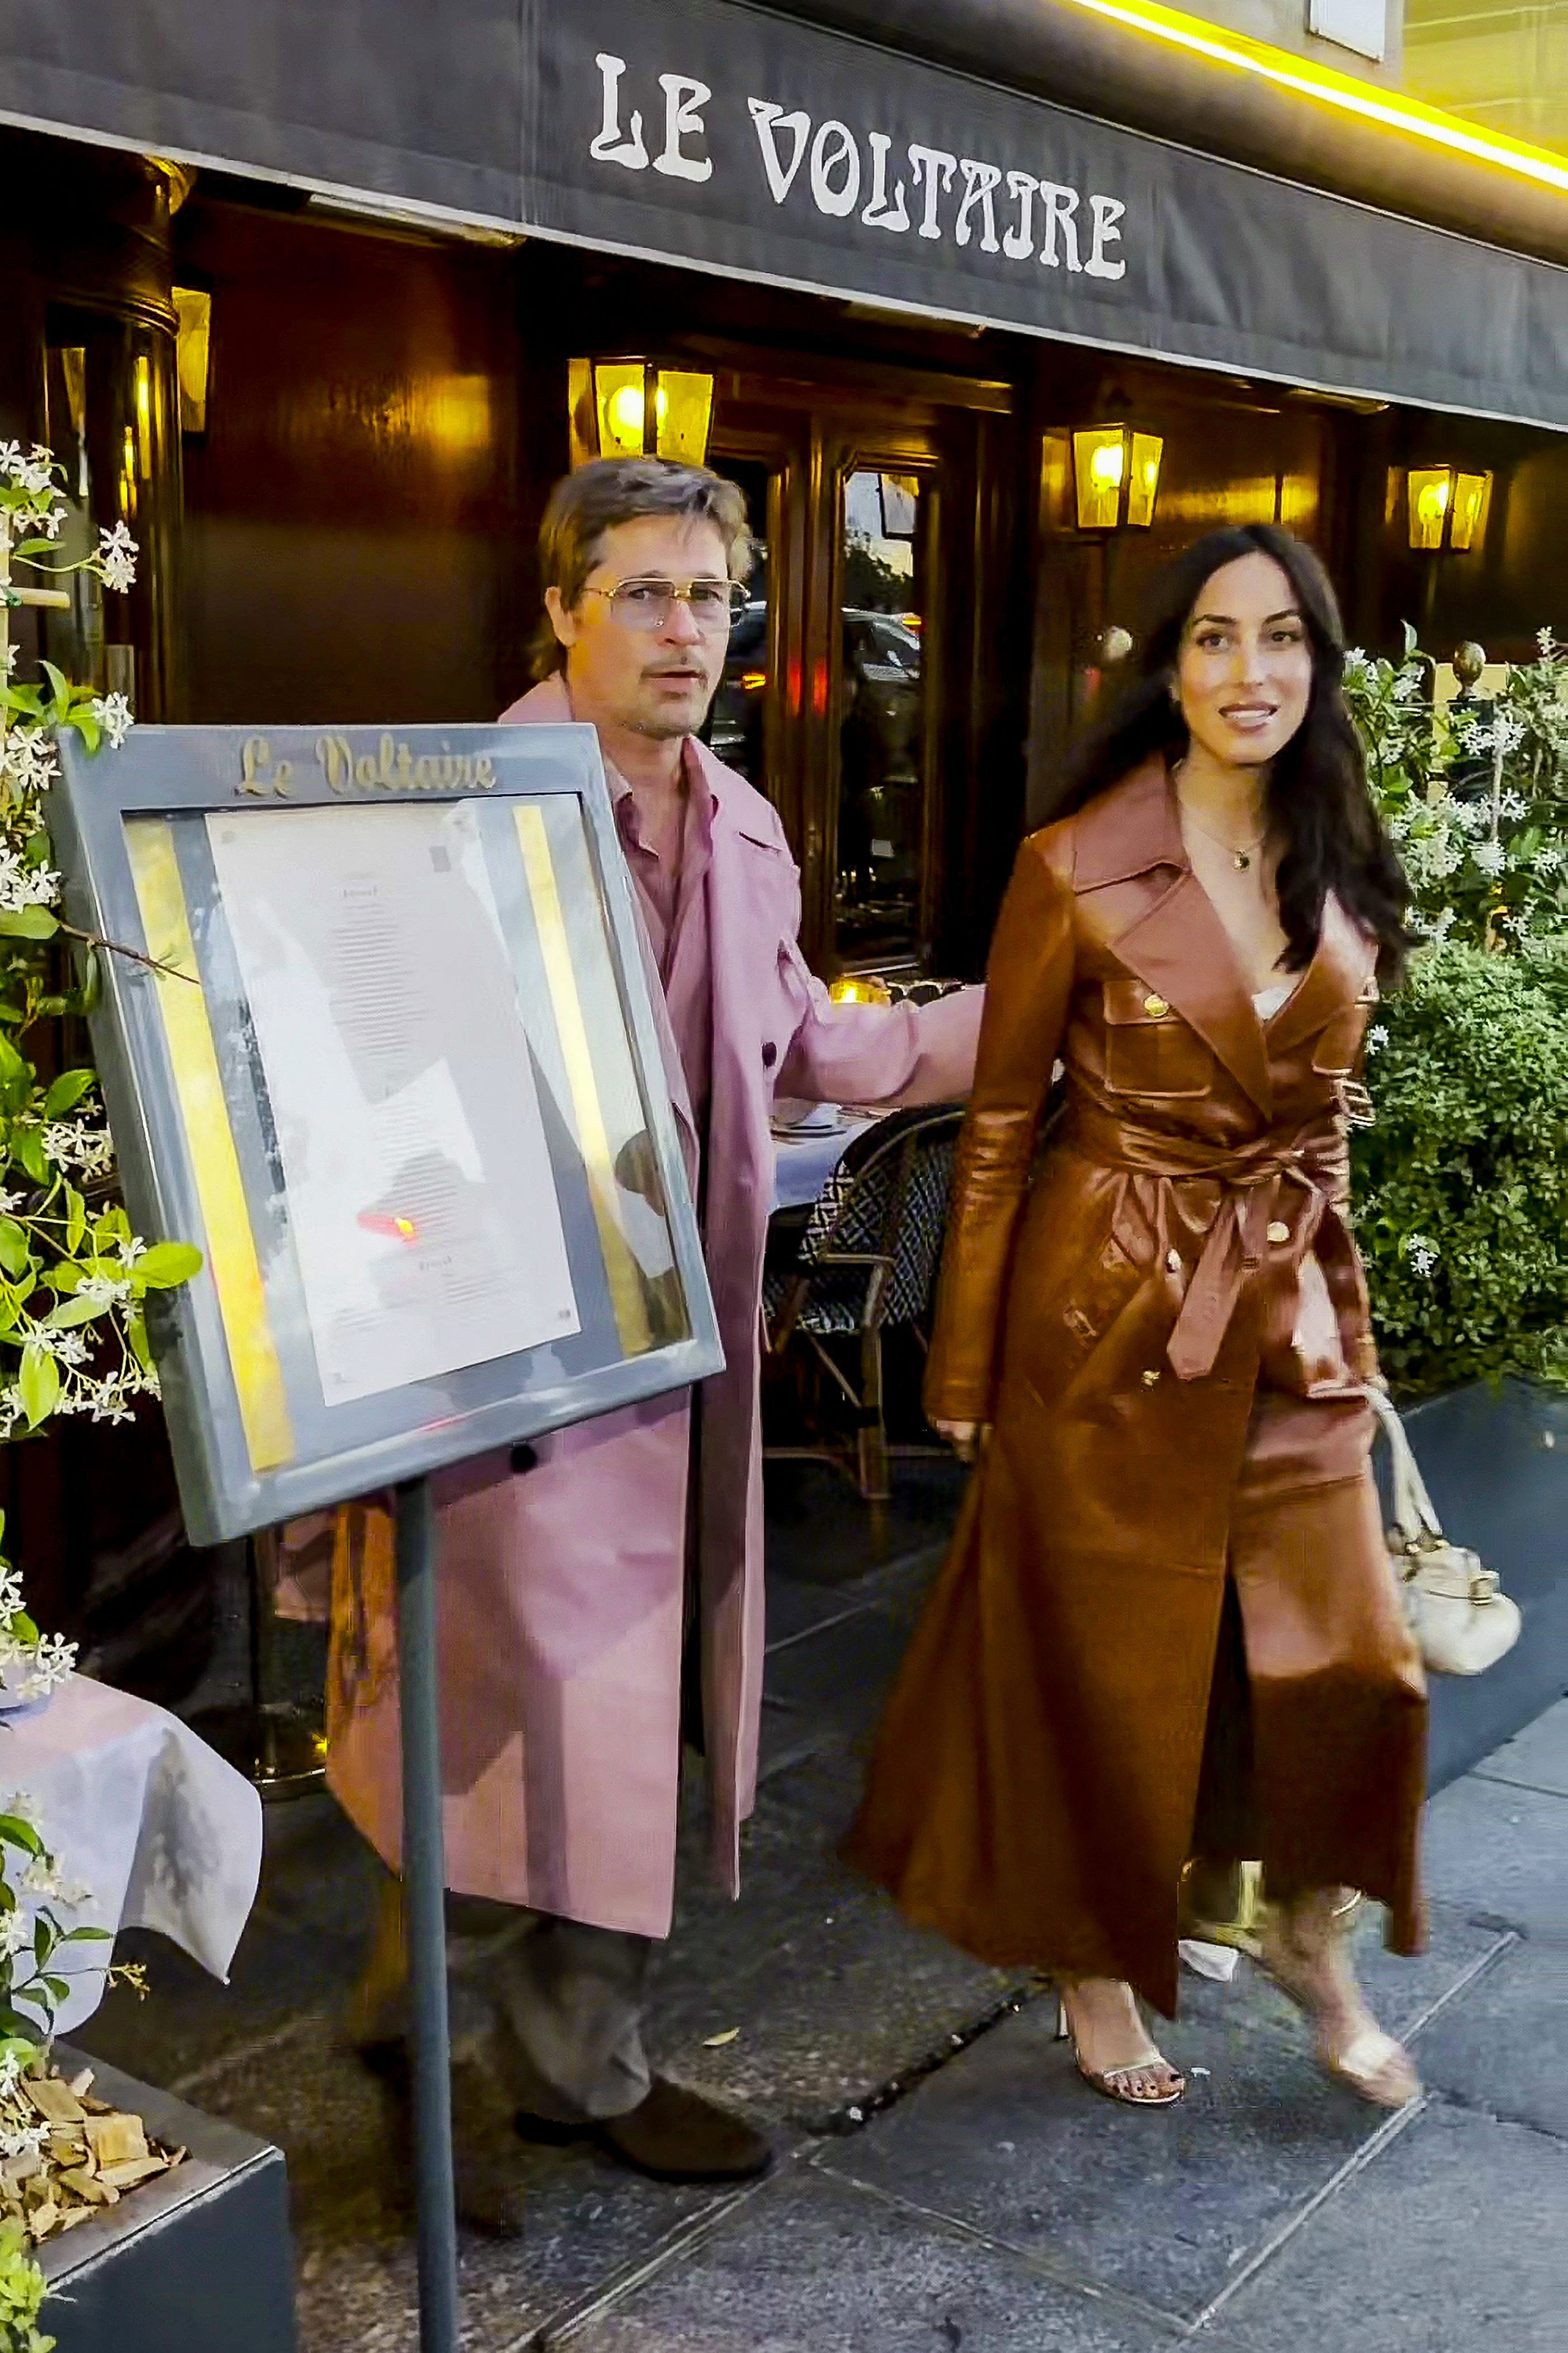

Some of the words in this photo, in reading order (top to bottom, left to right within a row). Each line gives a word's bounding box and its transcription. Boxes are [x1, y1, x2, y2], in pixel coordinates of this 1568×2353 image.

[590, 53, 712, 182] LE
[747, 97, 1126, 280] VOLTAIRE
[233, 735, 292, 798] Le
[315, 733, 496, 794] Voltaire
